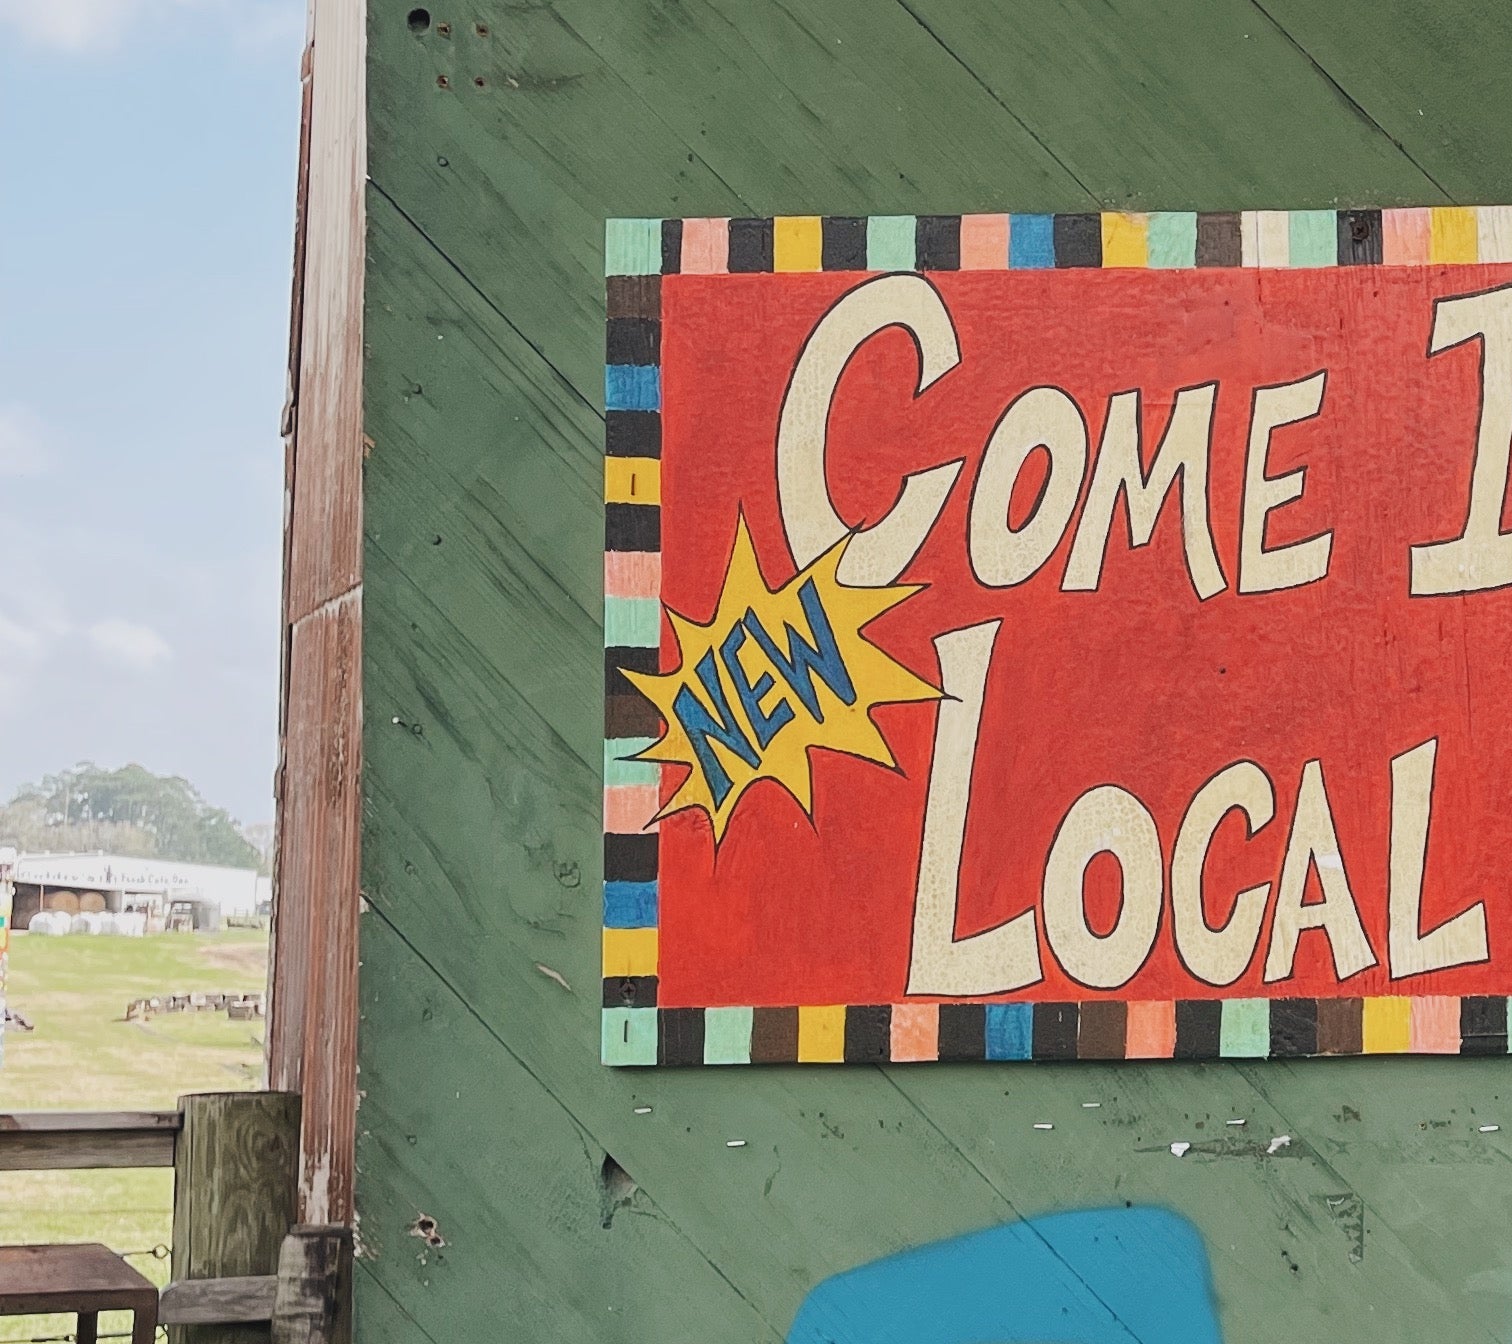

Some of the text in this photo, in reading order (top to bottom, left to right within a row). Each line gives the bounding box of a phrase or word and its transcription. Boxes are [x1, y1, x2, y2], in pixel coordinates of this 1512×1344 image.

[775, 271, 1333, 601] COME
[672, 575, 858, 813] NEW
[905, 618, 1492, 998] LOCAL
